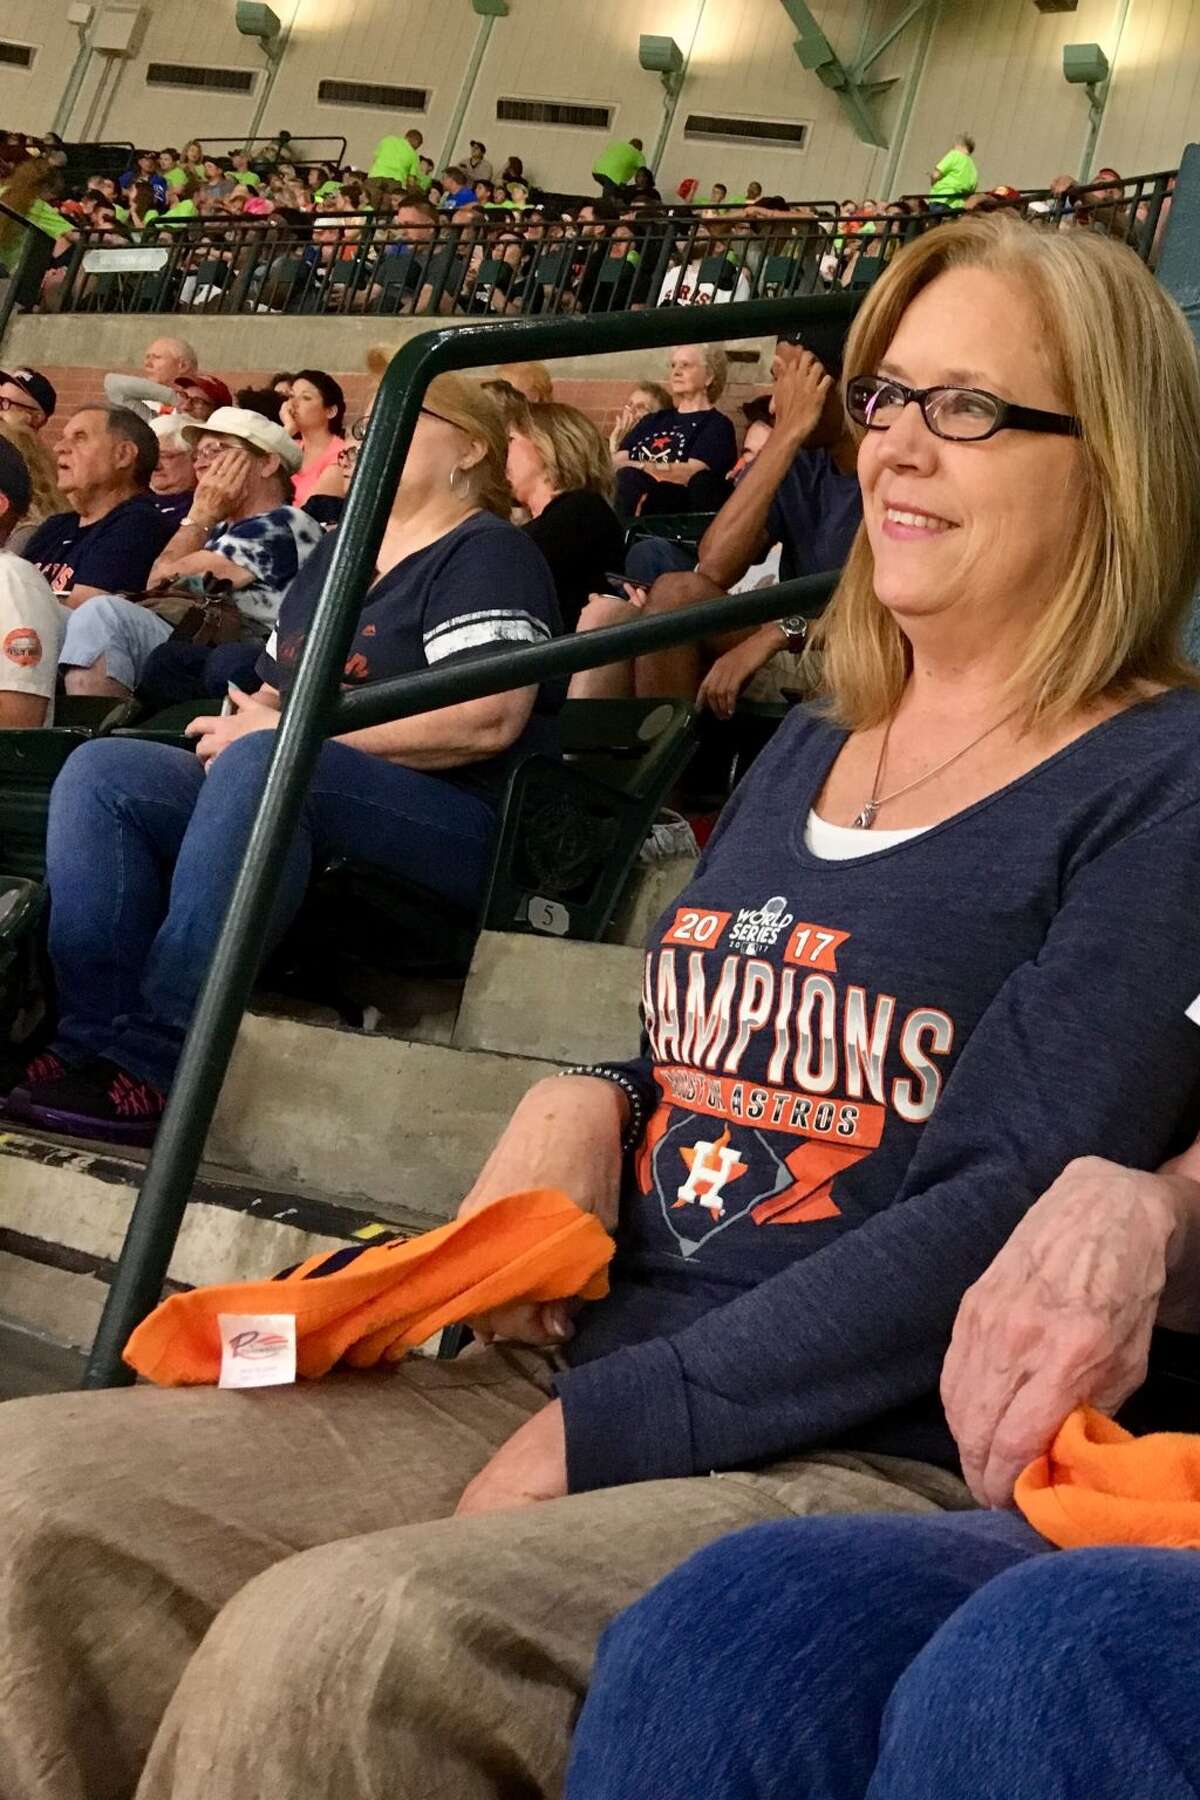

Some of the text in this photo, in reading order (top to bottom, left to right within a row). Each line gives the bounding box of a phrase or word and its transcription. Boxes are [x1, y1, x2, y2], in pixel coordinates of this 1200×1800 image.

[541, 903, 555, 926] 5
[737, 908, 794, 929] WORLD
[673, 913, 835, 962] 20 17
[729, 923, 781, 945] SERIES
[731, 1083, 859, 1138] ASTROS
[677, 1140, 742, 1210] H
